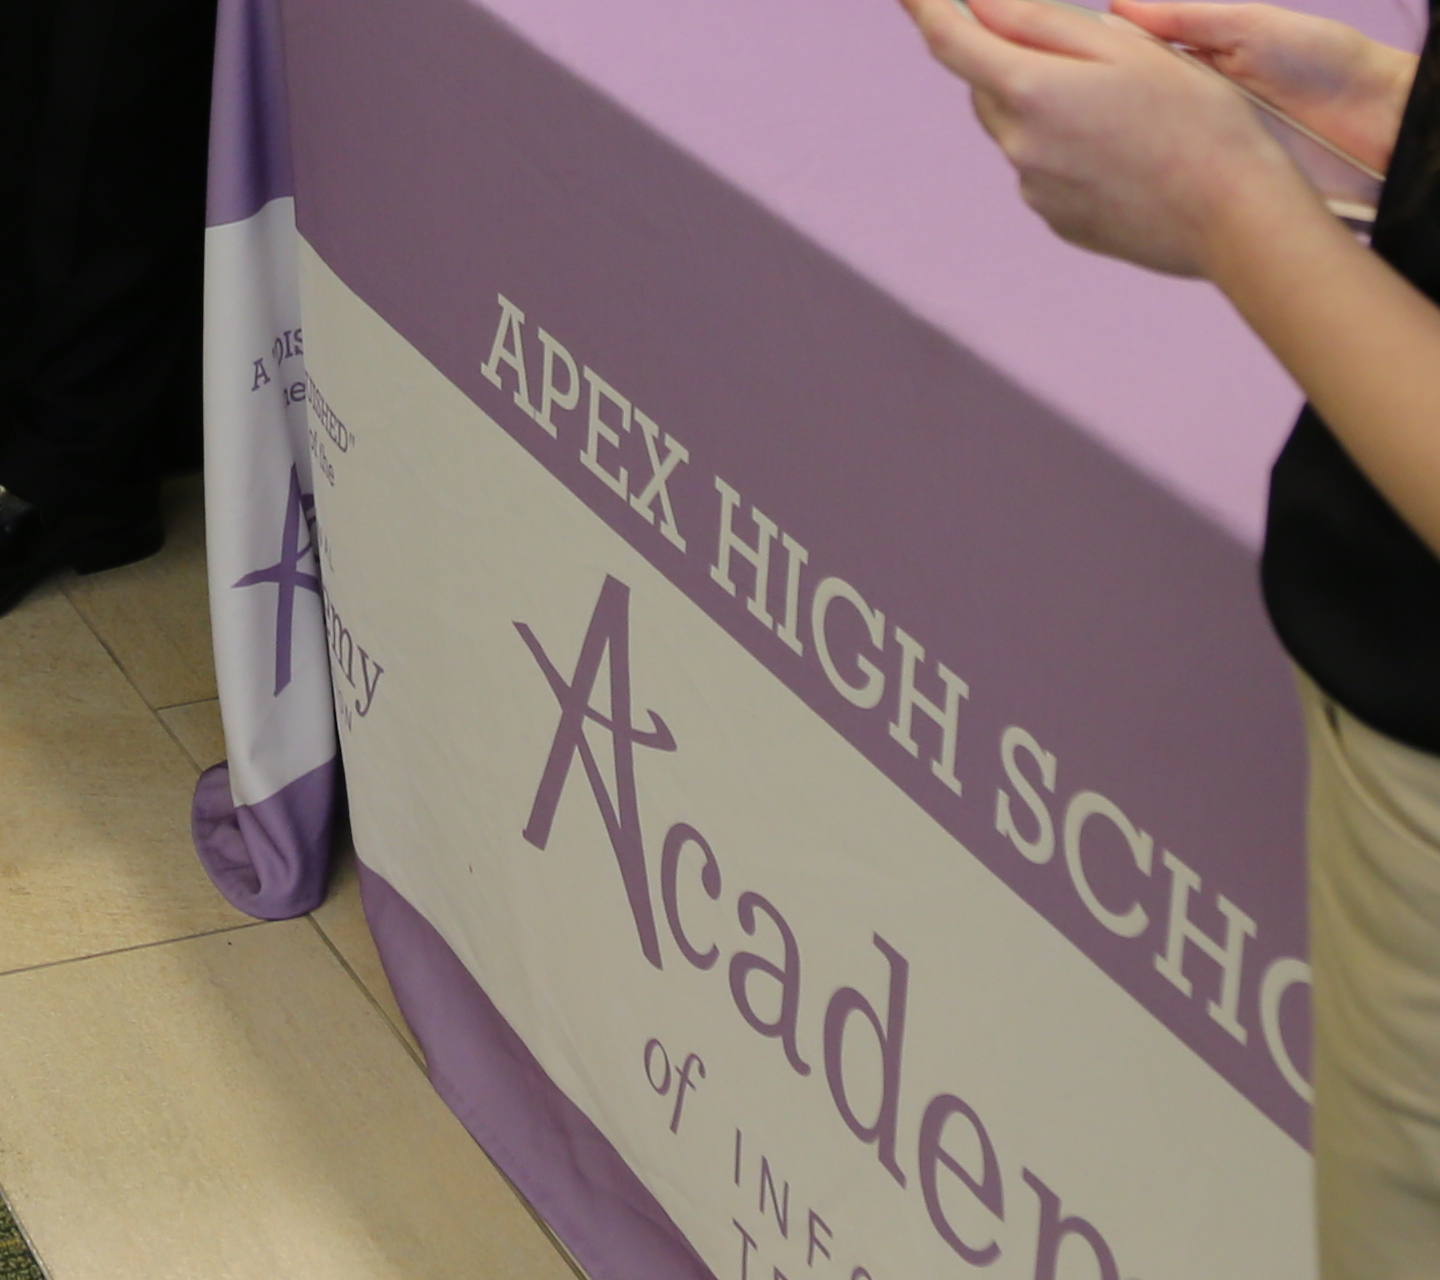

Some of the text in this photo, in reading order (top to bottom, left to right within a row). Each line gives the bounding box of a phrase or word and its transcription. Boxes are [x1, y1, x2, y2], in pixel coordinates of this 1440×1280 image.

[480, 292, 691, 555] APEX
[710, 474, 971, 799] HIGH
[643, 1037, 707, 1135] of
[733, 1126, 874, 1280] INF
